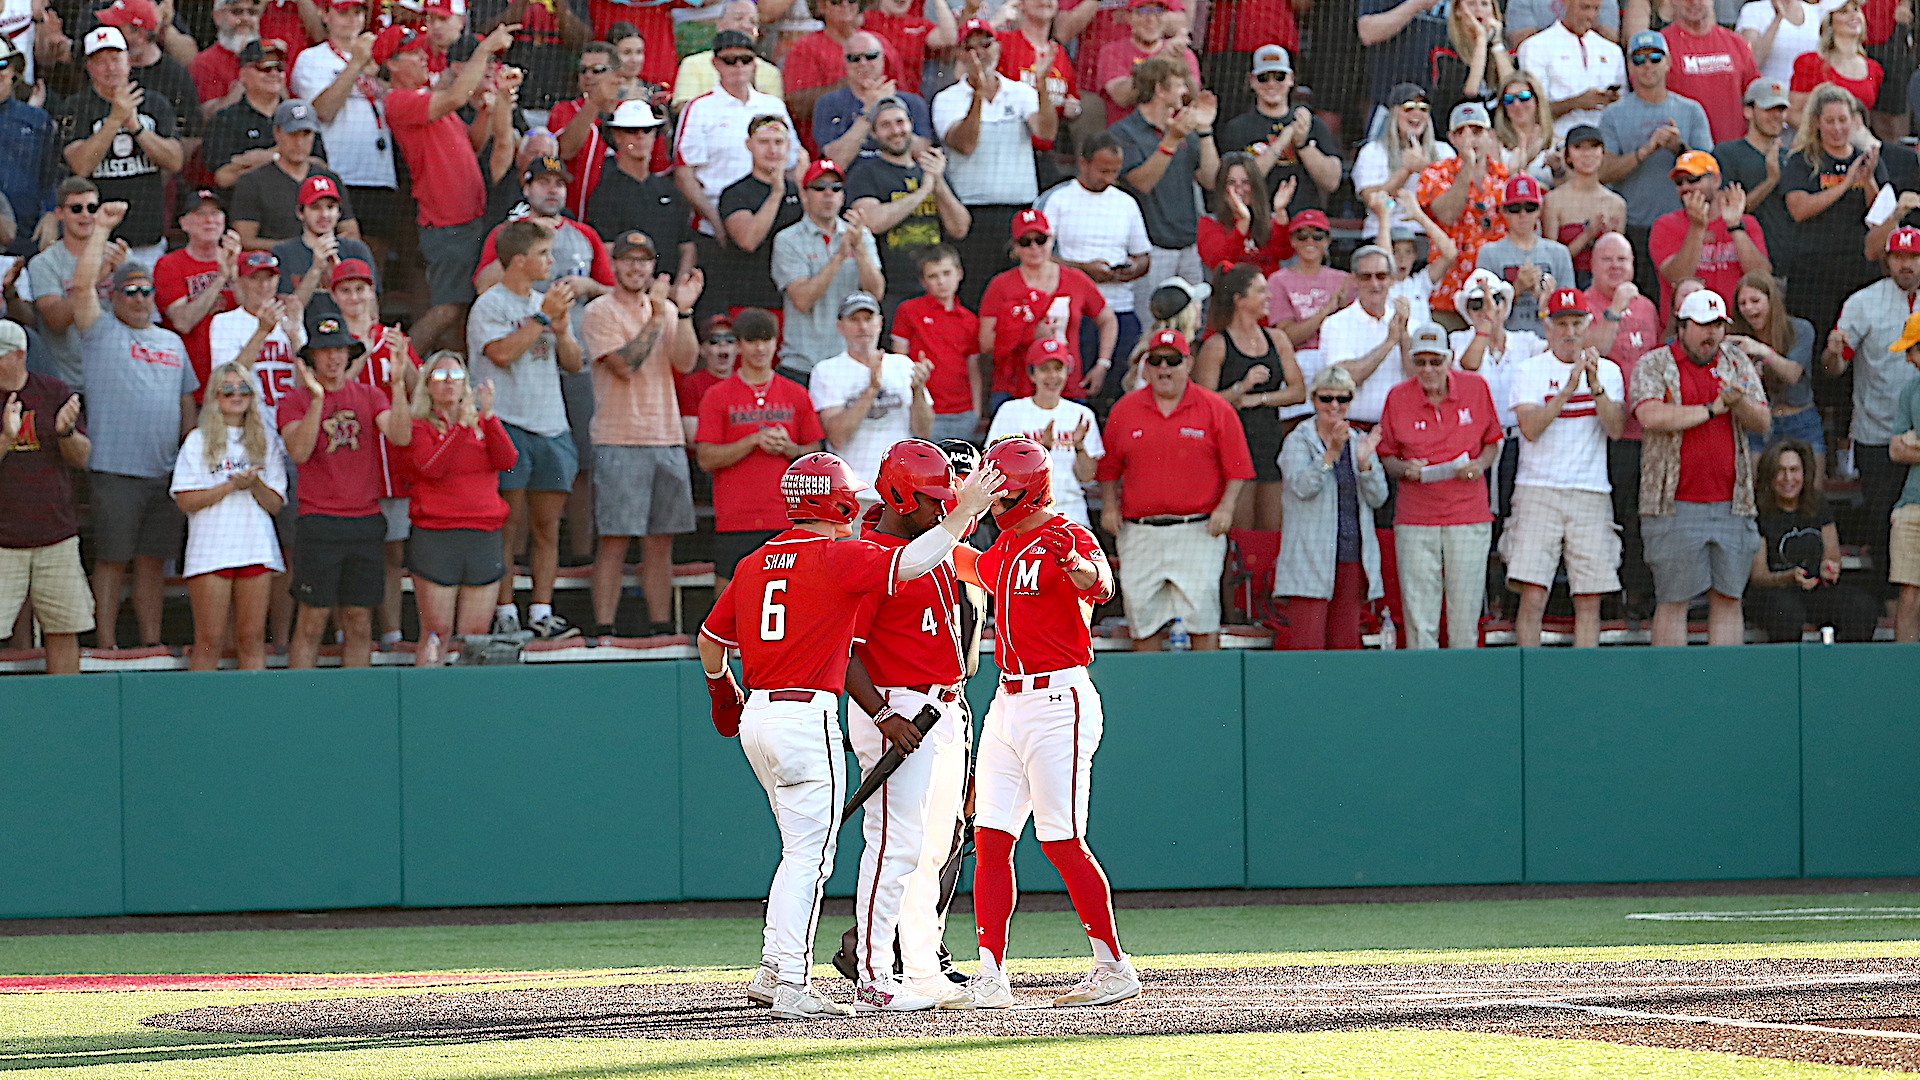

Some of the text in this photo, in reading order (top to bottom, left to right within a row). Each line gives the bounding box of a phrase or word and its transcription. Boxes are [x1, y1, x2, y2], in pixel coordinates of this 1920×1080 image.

[1899, 234, 1914, 247] M
[1560, 292, 1575, 307] M
[762, 552, 798, 570] SHAW
[1013, 559, 1042, 591] M
[760, 579, 788, 641] 6
[921, 606, 938, 636] 4
